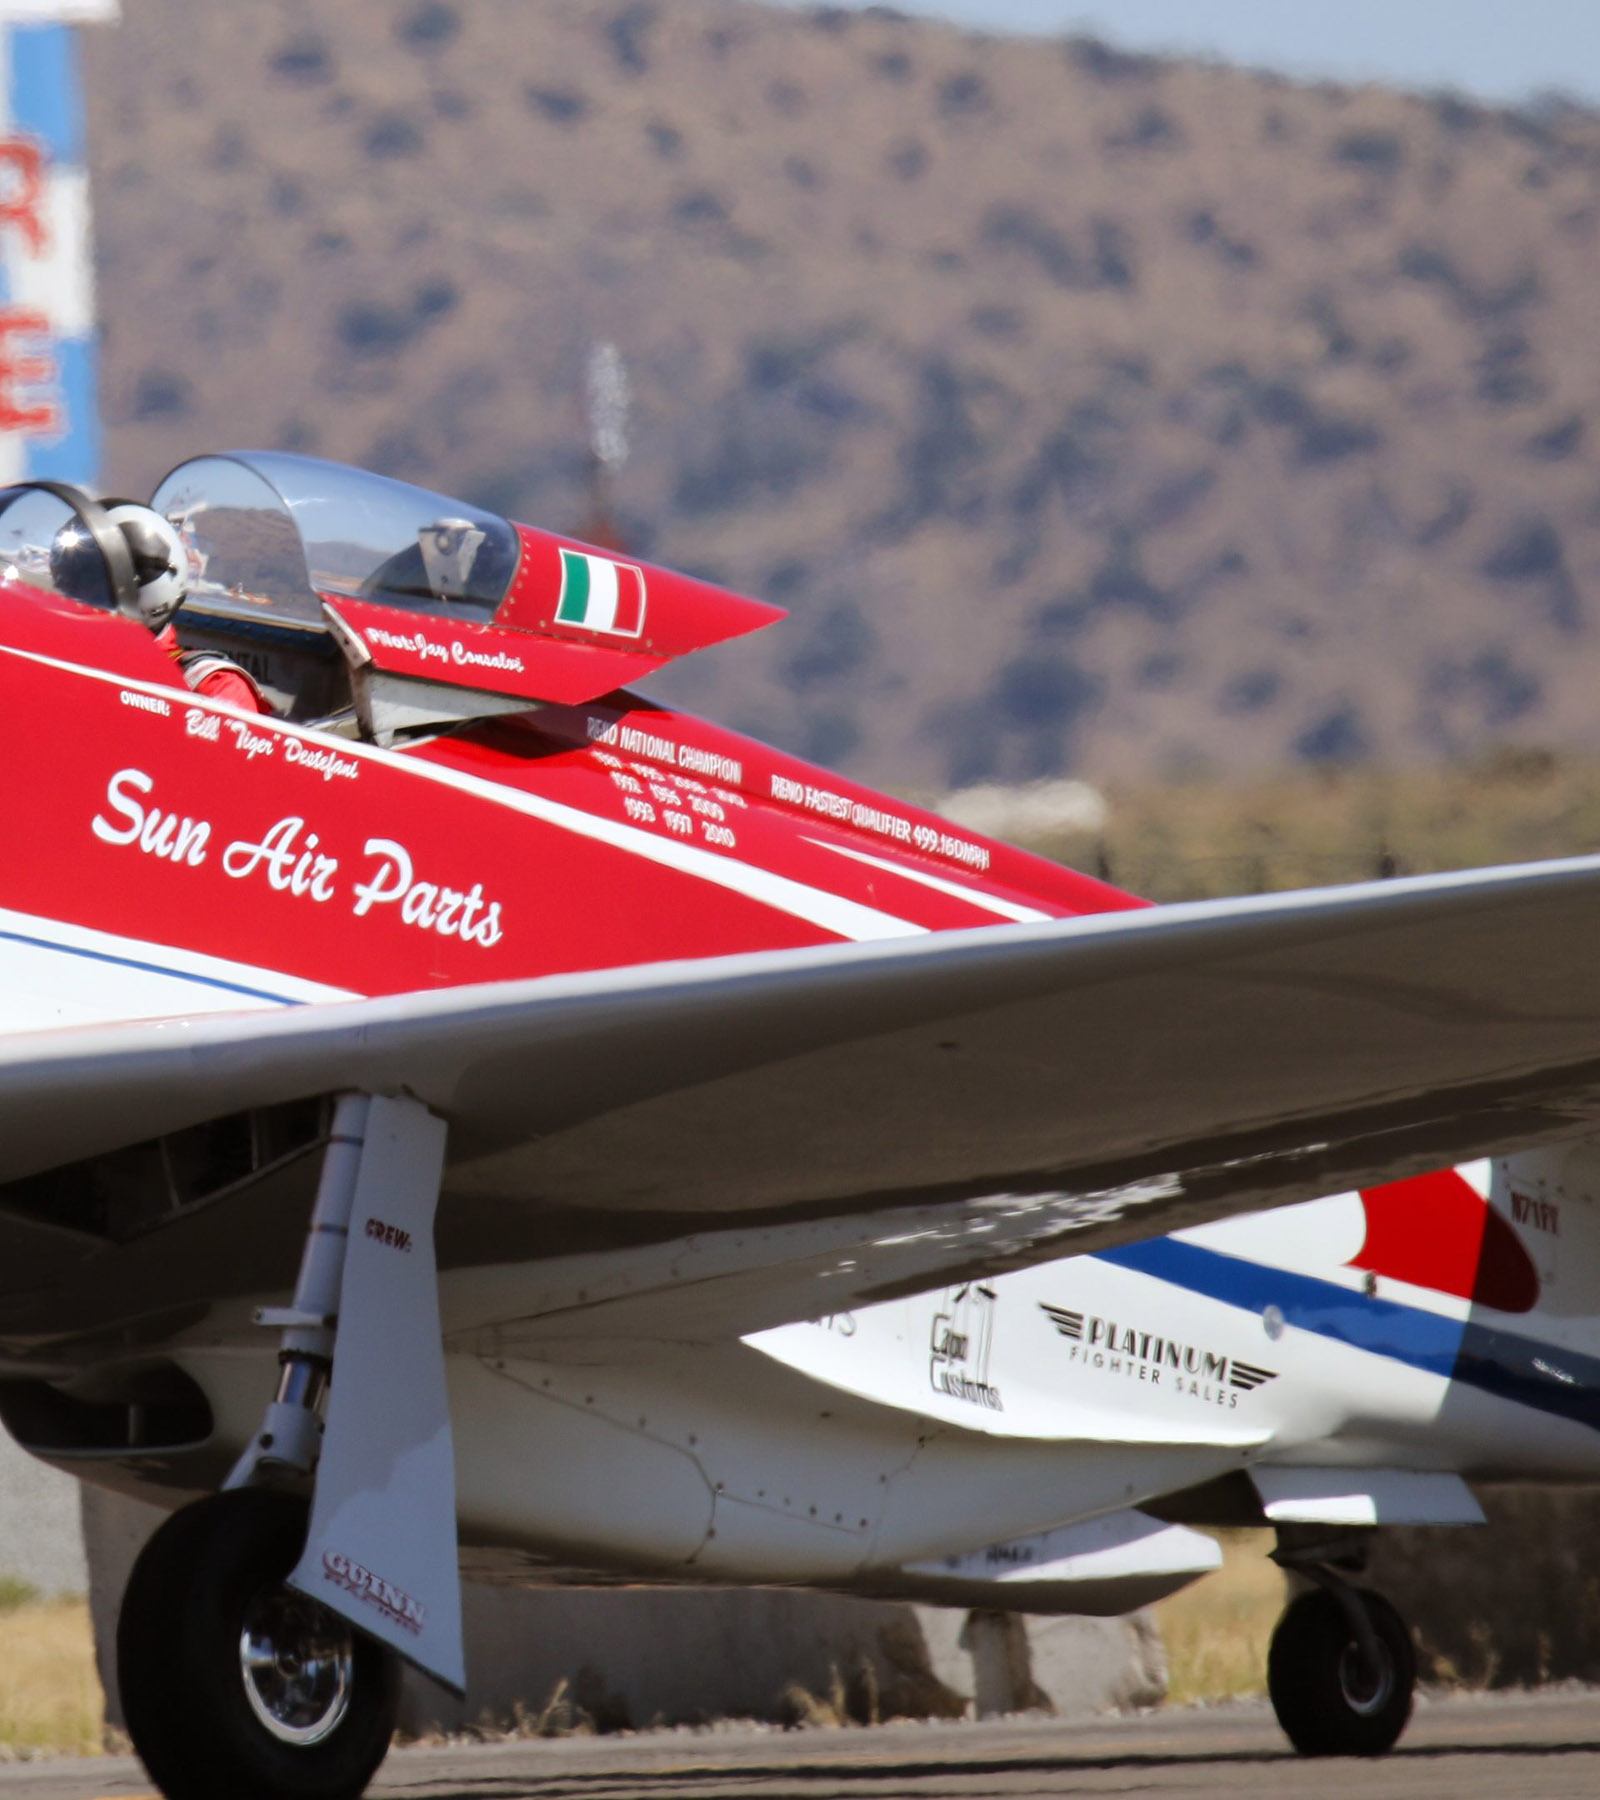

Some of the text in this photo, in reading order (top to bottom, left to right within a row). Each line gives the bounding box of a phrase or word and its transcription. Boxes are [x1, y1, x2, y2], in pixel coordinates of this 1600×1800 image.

[414, 632, 448, 662] Jay
[120, 691, 171, 716] OWNER:
[185, 709, 222, 741] Bill
[586, 716, 743, 786] RENO NATIONAL CHAMPION
[770, 773, 804, 804] RENO
[804, 785, 854, 826] FASTEST
[852, 803, 911, 843] QUALIFIER
[91, 768, 504, 948] Sun Air Parts
[364, 1217, 412, 1254] CREW:
[1069, 1346, 1239, 1409] FIGHTER SALES
[1088, 1316, 1228, 1382] PLATINUM
